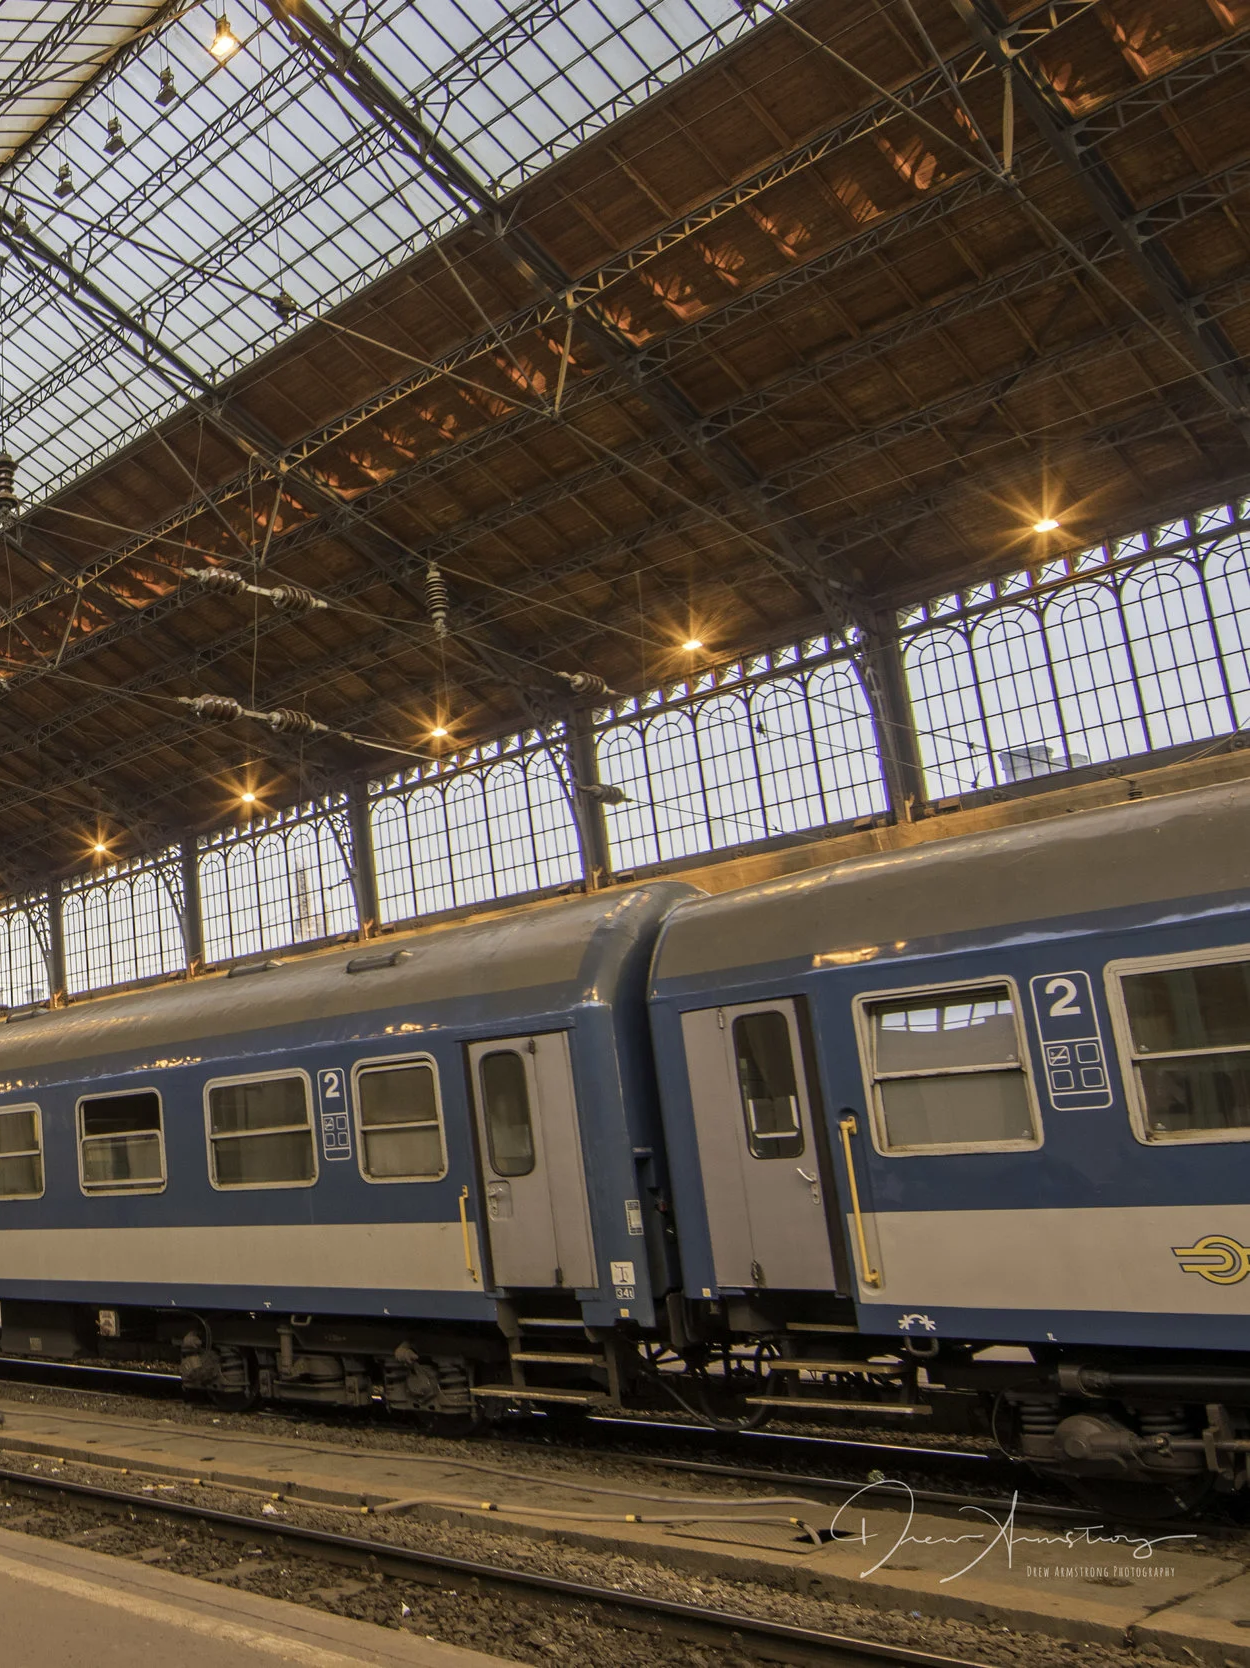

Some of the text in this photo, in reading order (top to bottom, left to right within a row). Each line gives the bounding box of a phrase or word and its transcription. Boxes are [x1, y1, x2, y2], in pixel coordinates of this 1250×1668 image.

[1045, 978, 1081, 1017] 2
[324, 1072, 341, 1098] 2
[617, 1289, 634, 1298] 34t
